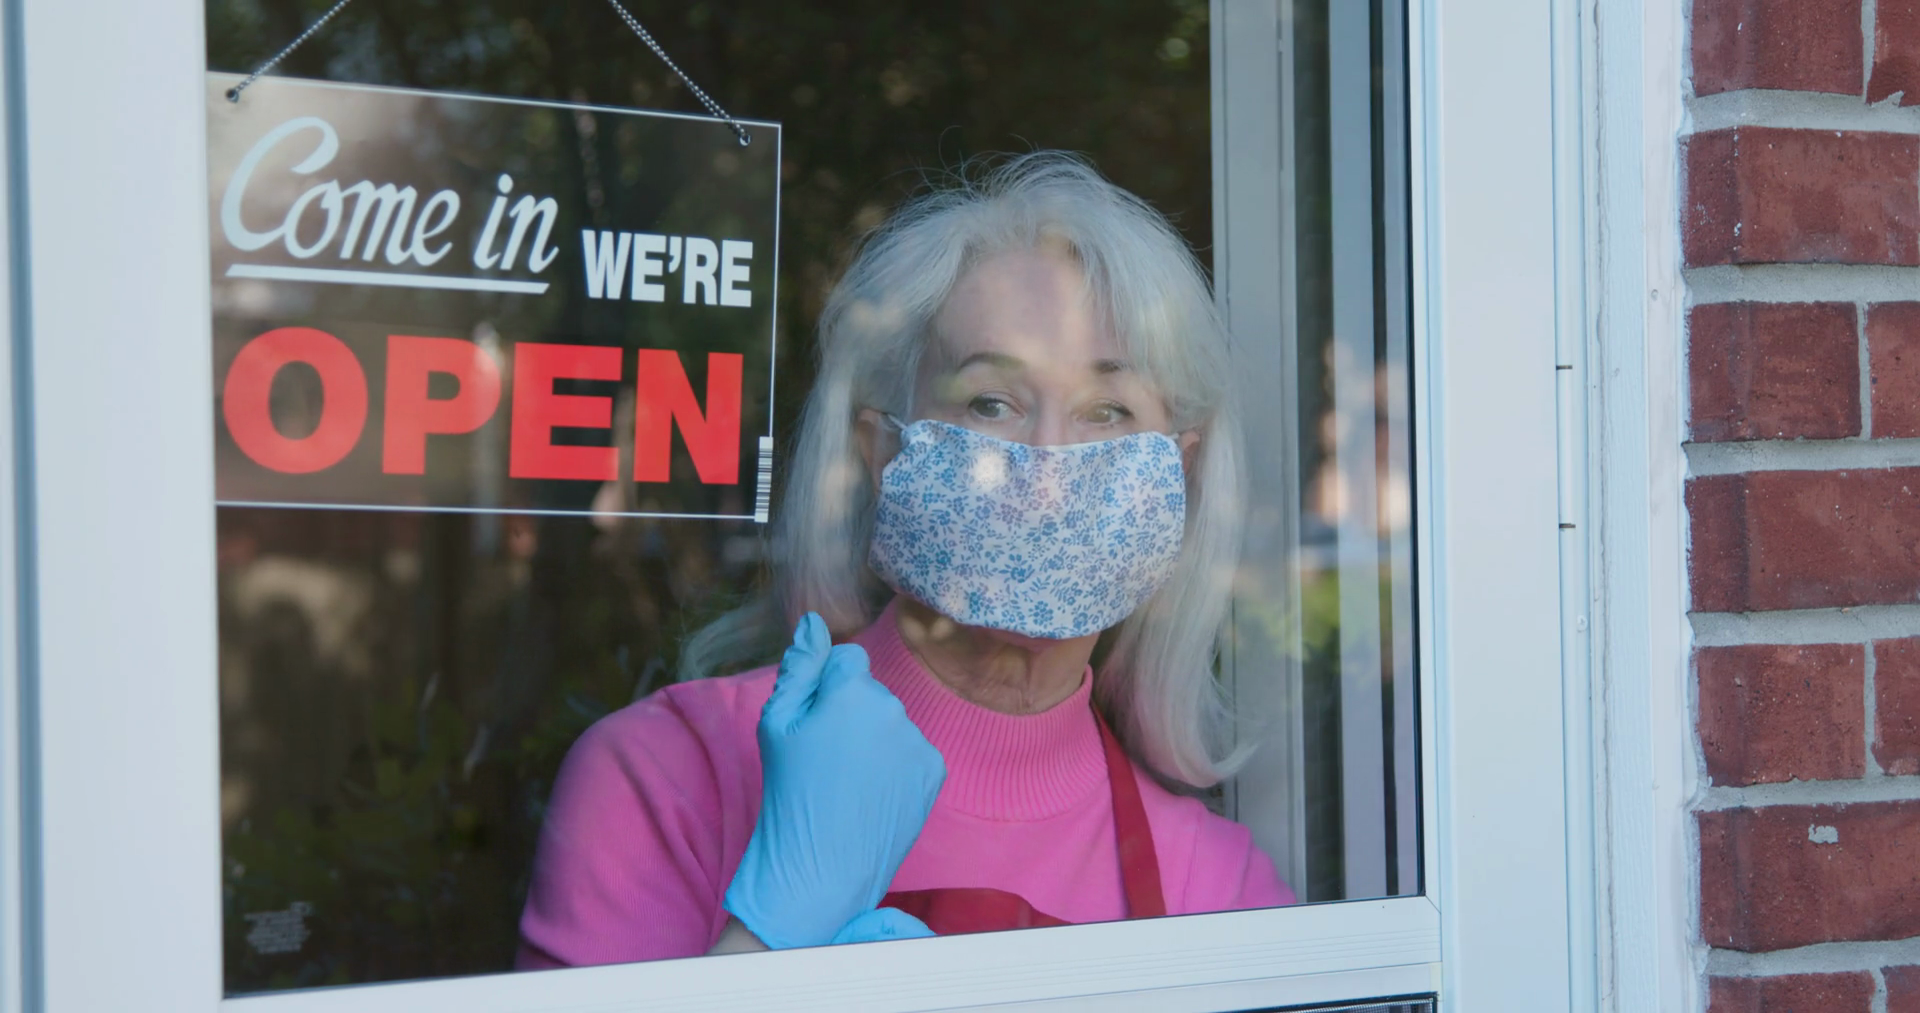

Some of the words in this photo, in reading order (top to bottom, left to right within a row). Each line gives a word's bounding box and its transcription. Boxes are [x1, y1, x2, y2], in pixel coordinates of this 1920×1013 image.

[220, 116, 460, 266] Come
[473, 173, 560, 273] in
[582, 229, 754, 307] WE'RE
[222, 326, 744, 485] OPEN
